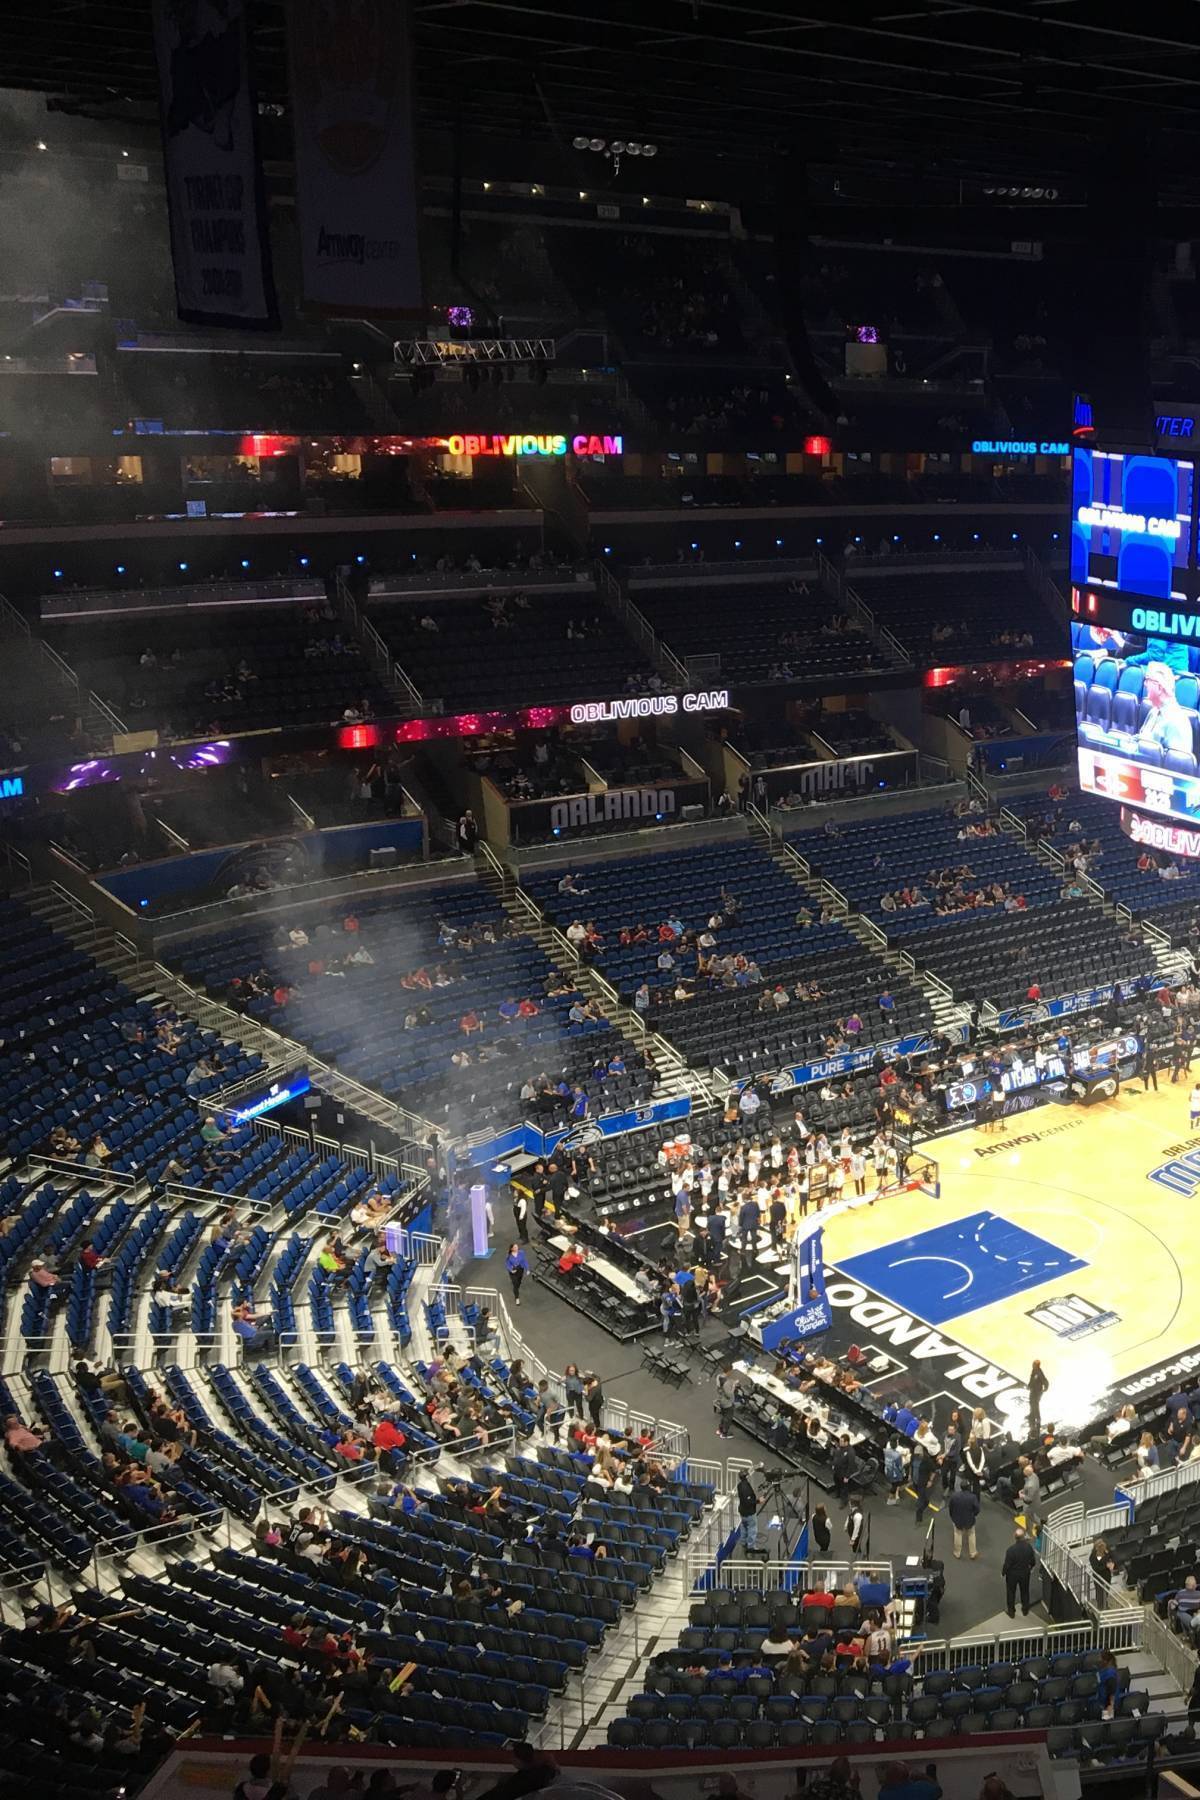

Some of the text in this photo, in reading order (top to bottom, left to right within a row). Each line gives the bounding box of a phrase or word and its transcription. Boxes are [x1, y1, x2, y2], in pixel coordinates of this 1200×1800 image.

[1156, 416, 1193, 437] TER
[449, 435, 622, 455] OBLIVIOUS CAM
[972, 441, 1070, 454] OBLIVIOUS CAM
[570, 690, 728, 723] OBLIVIOUS CAM
[551, 790, 676, 829] ORLANDO
[811, 1061, 845, 1079] PURE
[973, 1119, 1084, 1158] Amway CENTER
[794, 1314, 816, 1327] Olive
[798, 1318, 828, 1334] Garden
